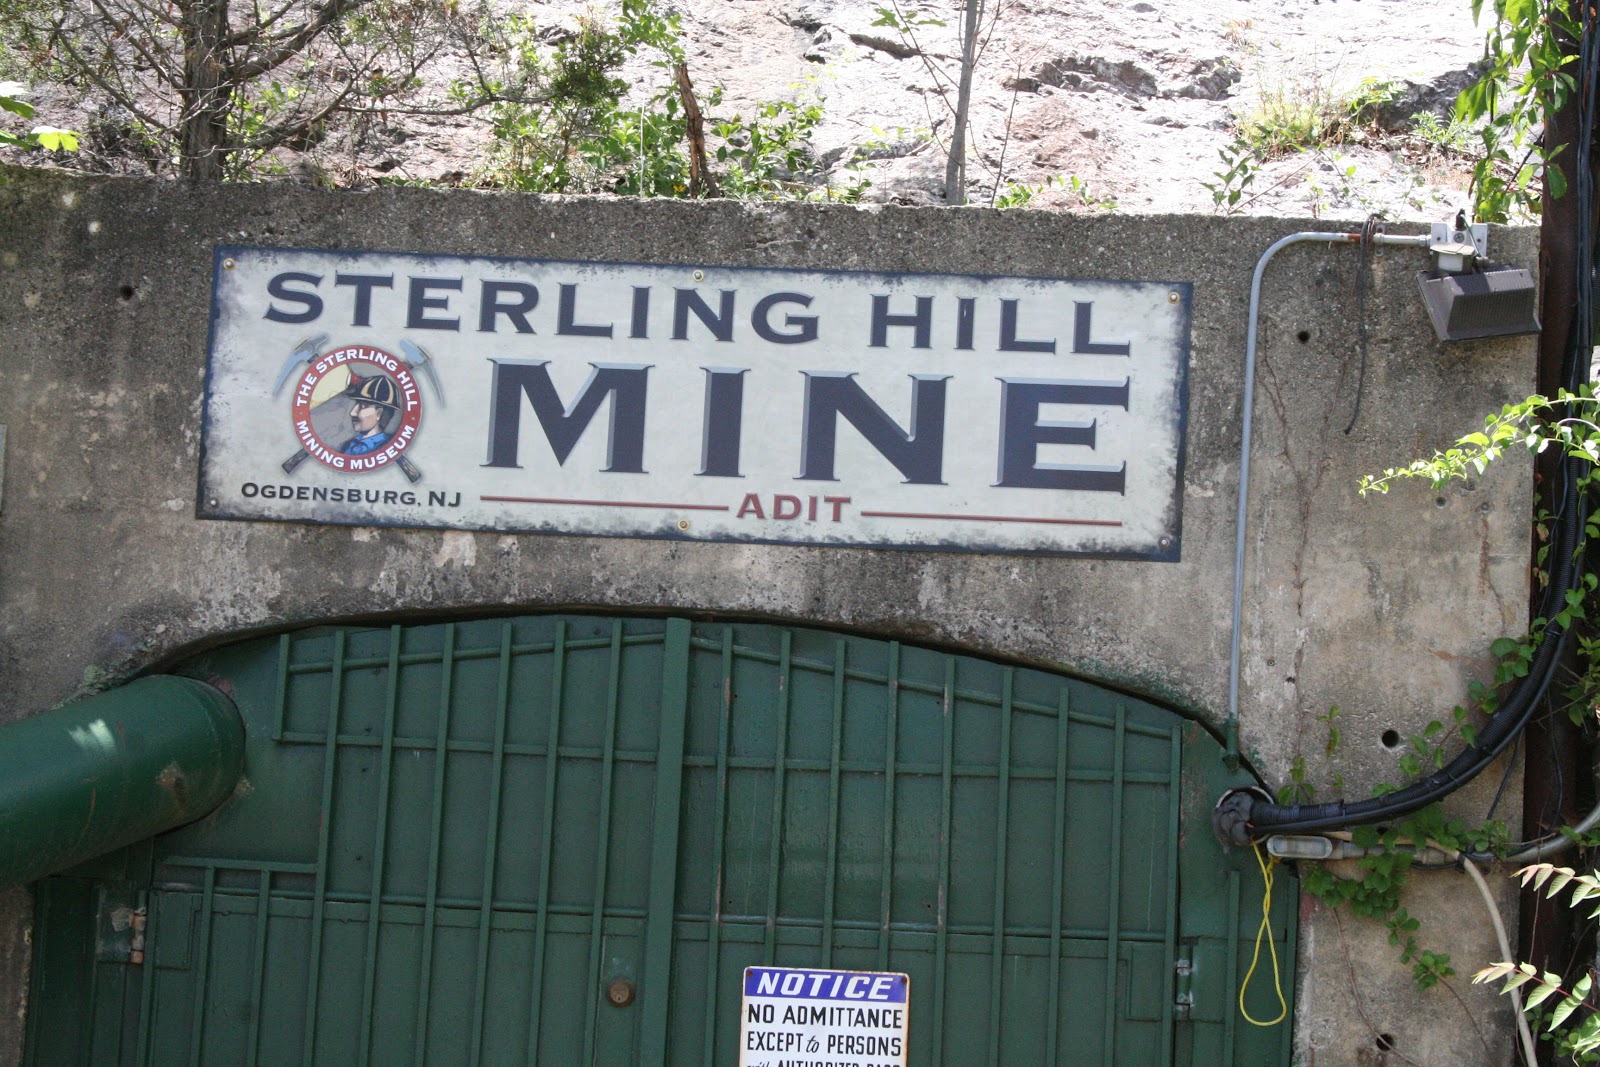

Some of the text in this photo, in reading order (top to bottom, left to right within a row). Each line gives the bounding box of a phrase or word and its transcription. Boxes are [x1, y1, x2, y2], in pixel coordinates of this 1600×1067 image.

[263, 270, 1131, 358] STERLING HILL
[296, 348, 418, 412] THE STERLING HILL
[479, 357, 1131, 497] MINE
[296, 420, 415, 470] MINING MUSEUM
[428, 491, 462, 507] NJ
[736, 493, 851, 522] ADIT
[756, 972, 893, 1000] NOTICE
[747, 1004, 903, 1029] NO ADMITTANCE
[747, 1031, 901, 1057] EXCEPT to PERSONS
